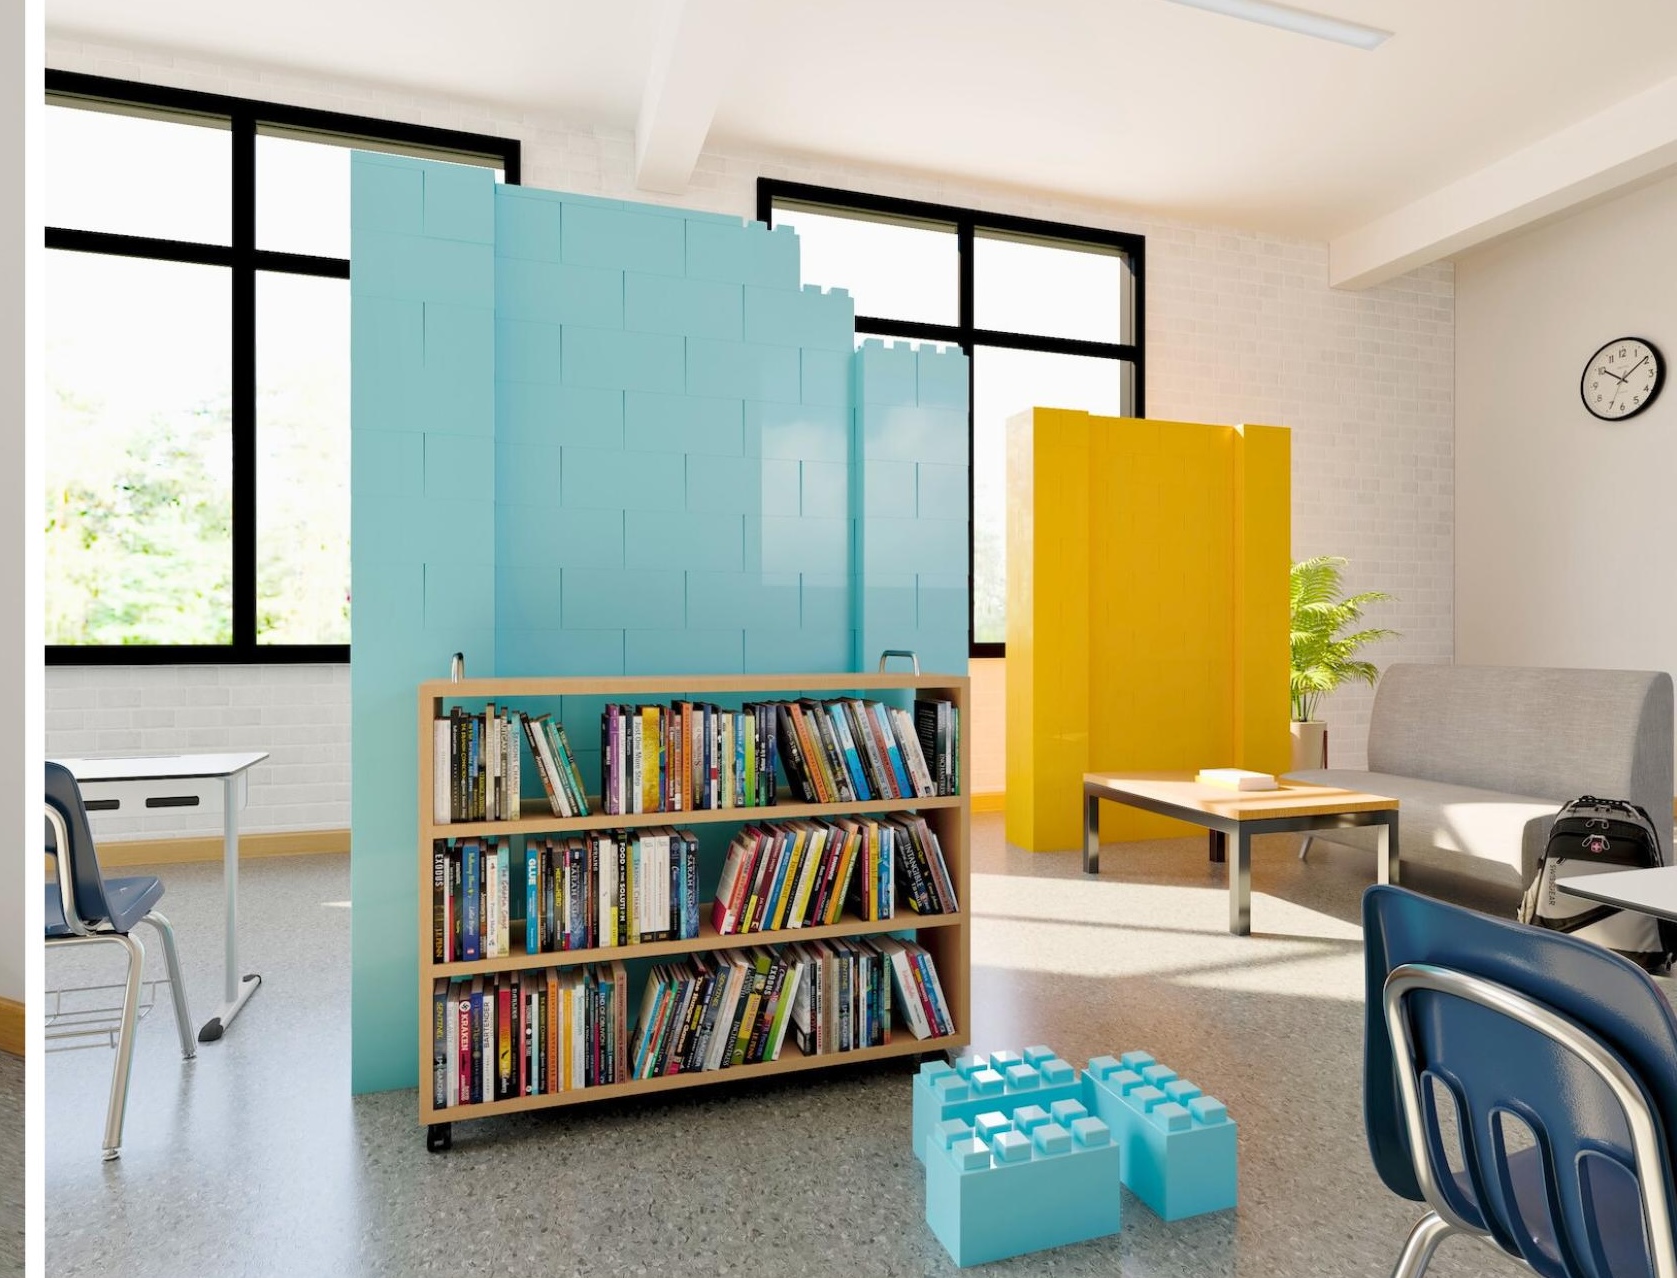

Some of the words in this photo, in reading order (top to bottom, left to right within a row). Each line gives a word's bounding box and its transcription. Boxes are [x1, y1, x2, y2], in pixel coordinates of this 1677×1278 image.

[1619, 349, 1627, 358] 12
[1648, 369, 1654, 378] 3
[1593, 382, 1599, 390] 9
[1643, 384, 1649, 392] 4
[1609, 400, 1614, 410] 7
[1620, 403, 1625, 411] 6
[1633, 396, 1639, 404] 5
[634, 752, 642, 769] More
[634, 771, 642, 786] Step
[435, 854, 443, 887] EXODUS
[528, 858, 536, 886] GLUE
[905, 842, 924, 887] INTANGIBLE
[571, 863, 579, 895] SARAH
[694, 977, 703, 991] The
[763, 965, 778, 995] EXODUS
[685, 993, 699, 1023] Hunger
[677, 1025, 689, 1054] Games
